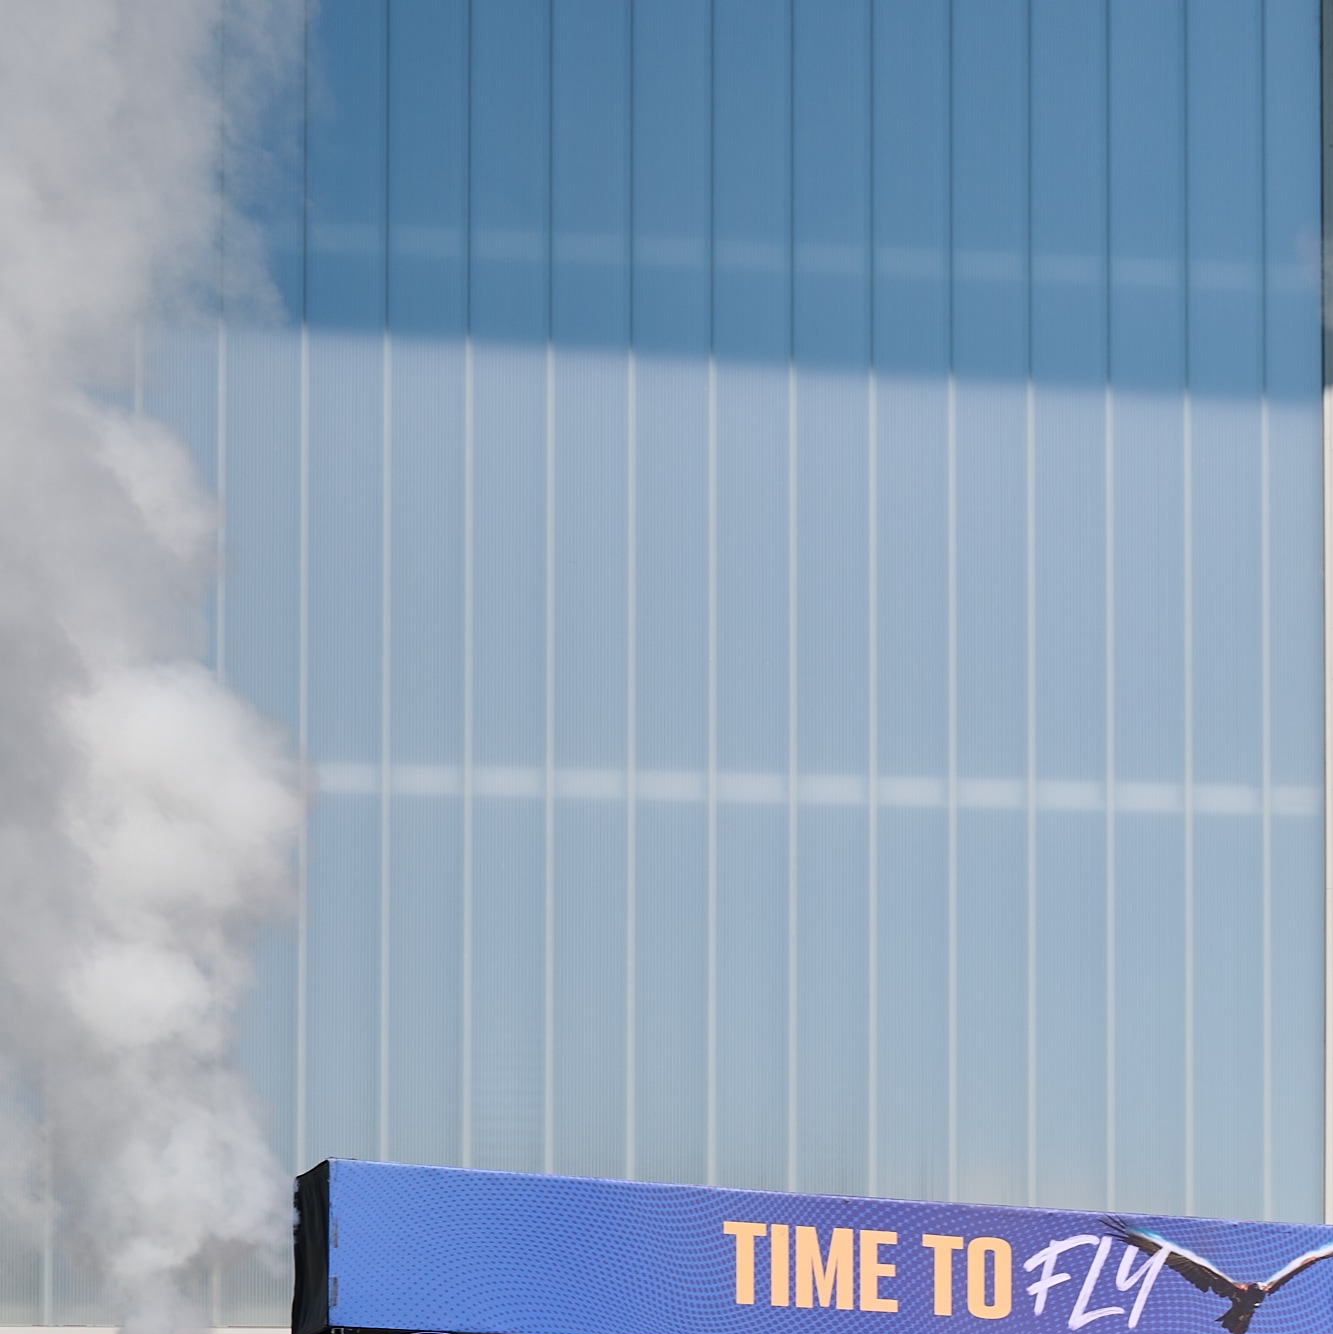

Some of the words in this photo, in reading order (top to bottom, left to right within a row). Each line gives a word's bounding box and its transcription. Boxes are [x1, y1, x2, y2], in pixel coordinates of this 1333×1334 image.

[723, 1221, 898, 1313] TIME
[922, 1233, 1012, 1320] TO
[1023, 1234, 1171, 1330] FLY
